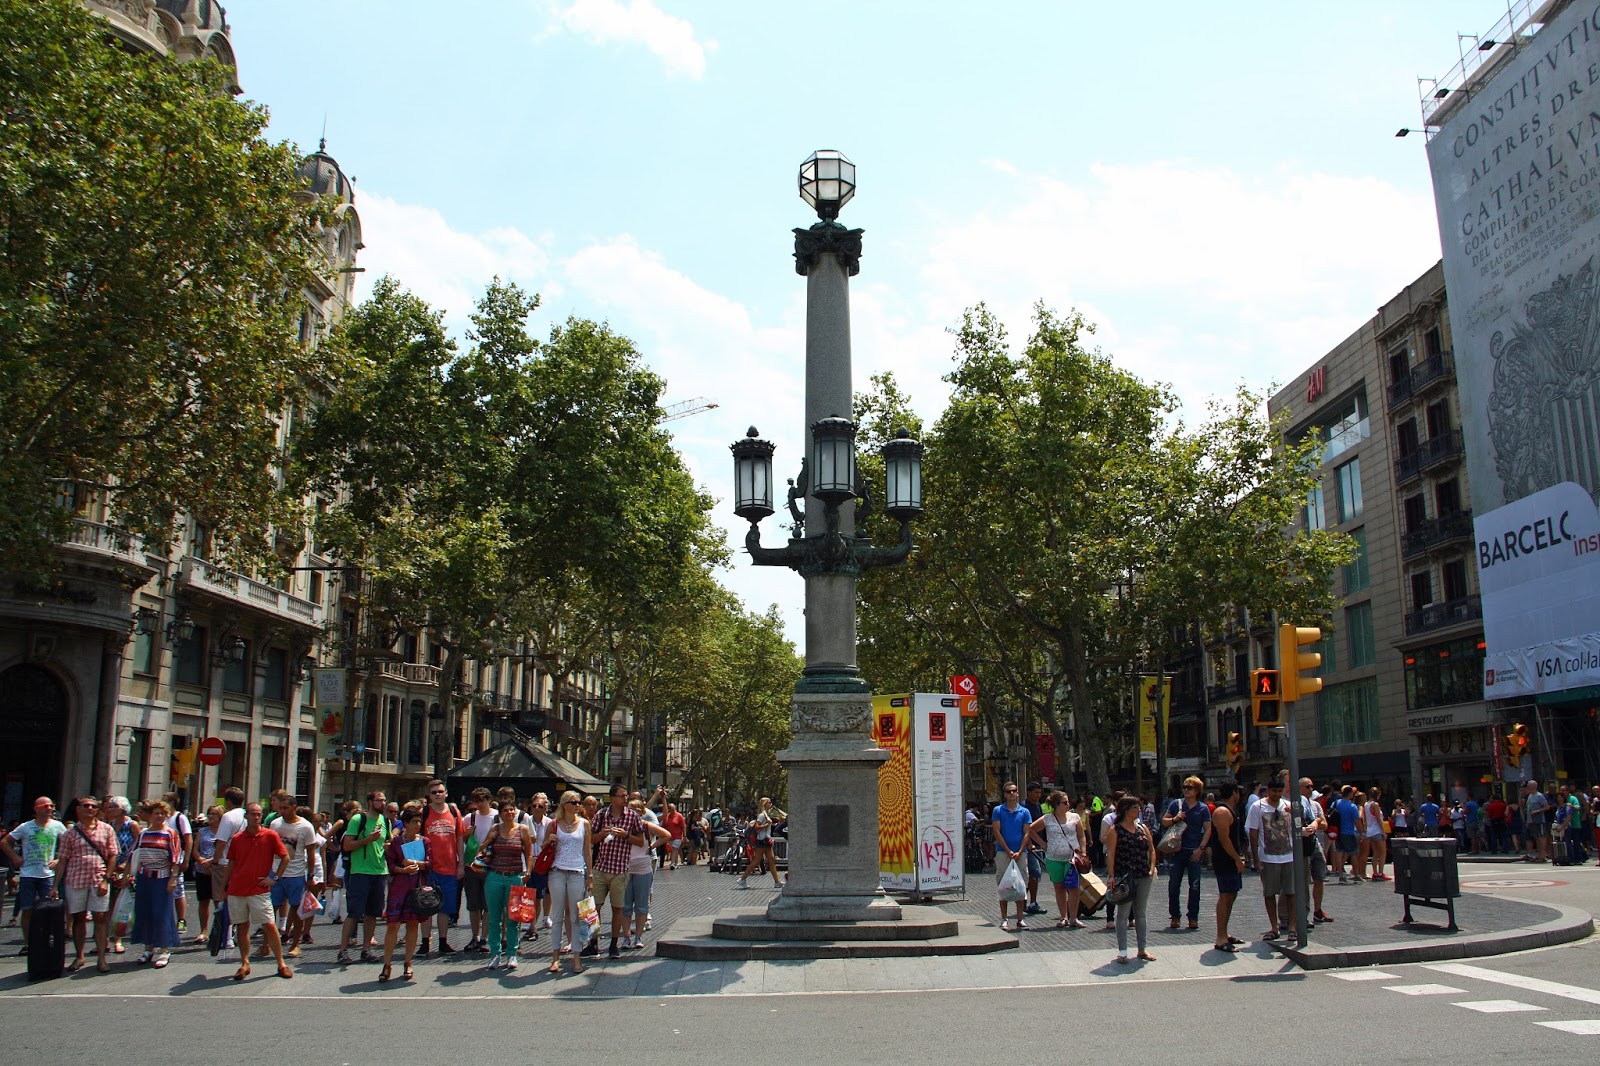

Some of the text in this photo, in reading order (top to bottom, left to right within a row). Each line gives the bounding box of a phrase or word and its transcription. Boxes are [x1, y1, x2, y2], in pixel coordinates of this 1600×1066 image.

[1471, 113, 1541, 186] ALTRES
[1535, 123, 1555, 149] DE
[1464, 189, 1540, 256] COMPILATS
[1548, 164, 1569, 194] EN
[1472, 245, 1491, 267] DEL
[1549, 189, 1566, 211] DE
[1572, 533, 1600, 556] ins
[1408, 714, 1453, 728] RESTAURANT
